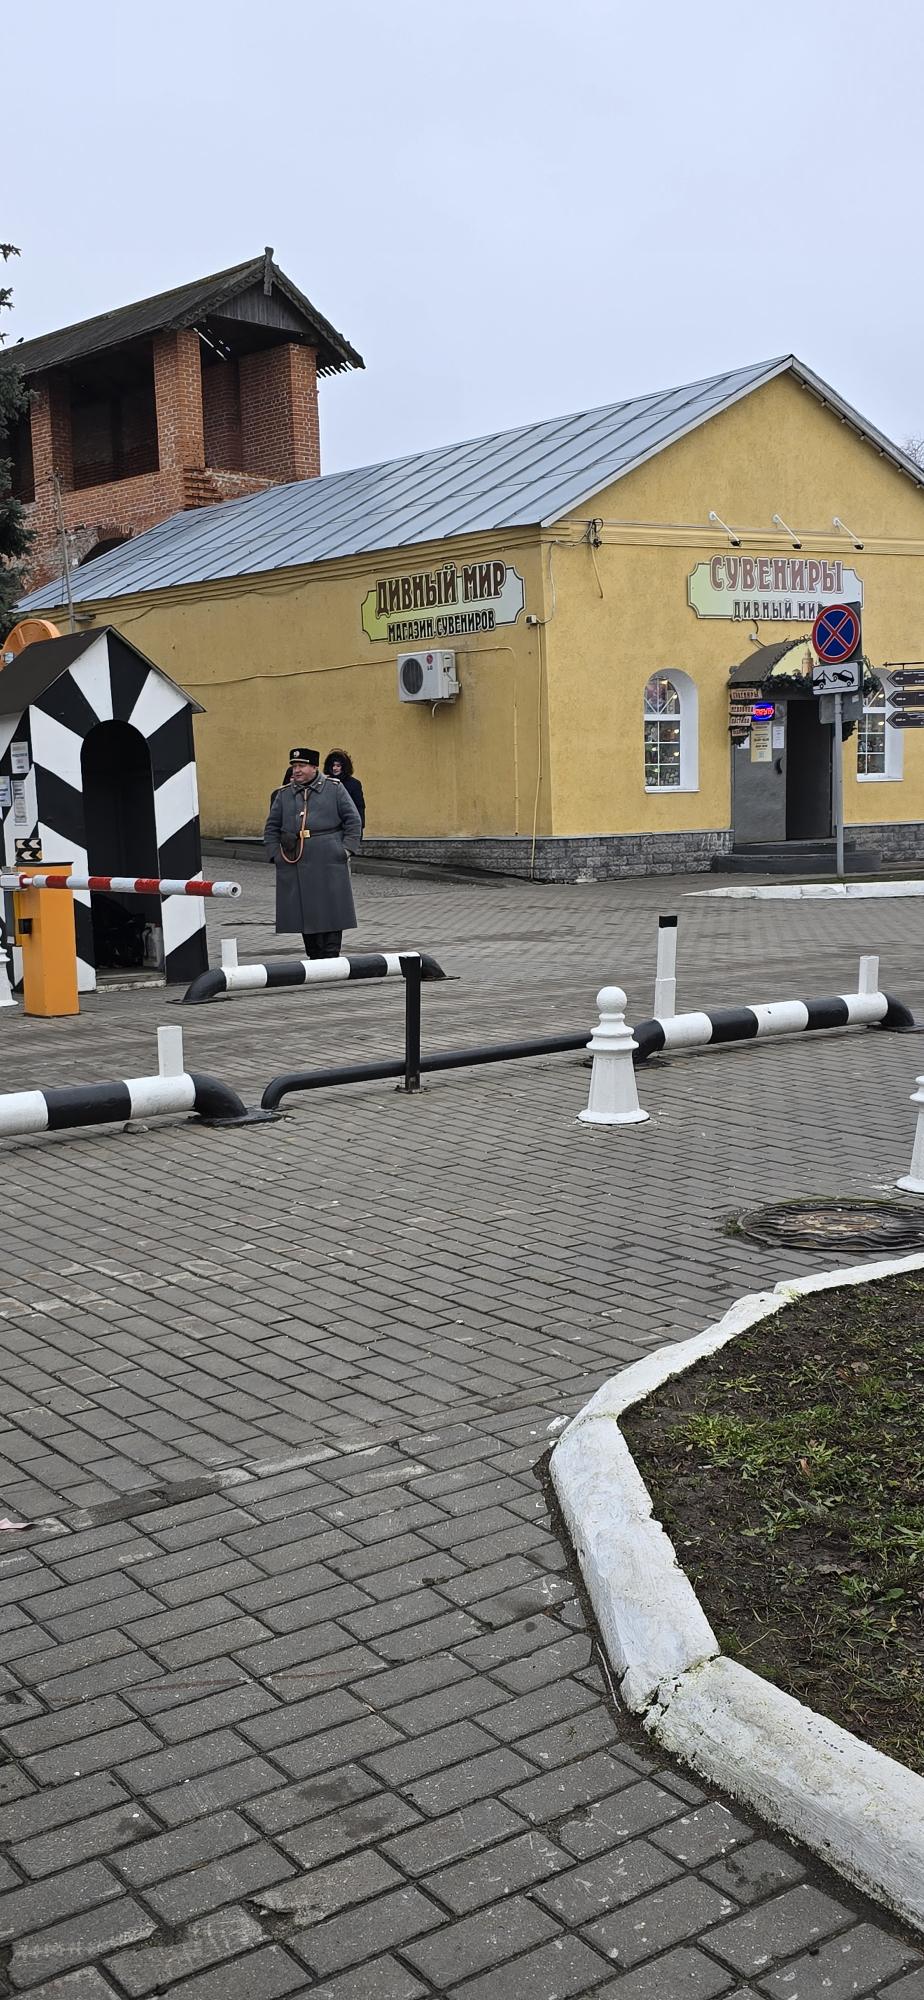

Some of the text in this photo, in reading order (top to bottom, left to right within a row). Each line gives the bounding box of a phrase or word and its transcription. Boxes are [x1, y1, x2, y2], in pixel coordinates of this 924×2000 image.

[376, 561, 506, 614] ДИВНЫЙ МИР
[710, 556, 843, 593] СУВЕНИРЫ
[388, 610, 495, 642] МАГАЗИН СУВЕНИРОВ
[733, 599, 822, 621] ДИВНЫЙ МИ
